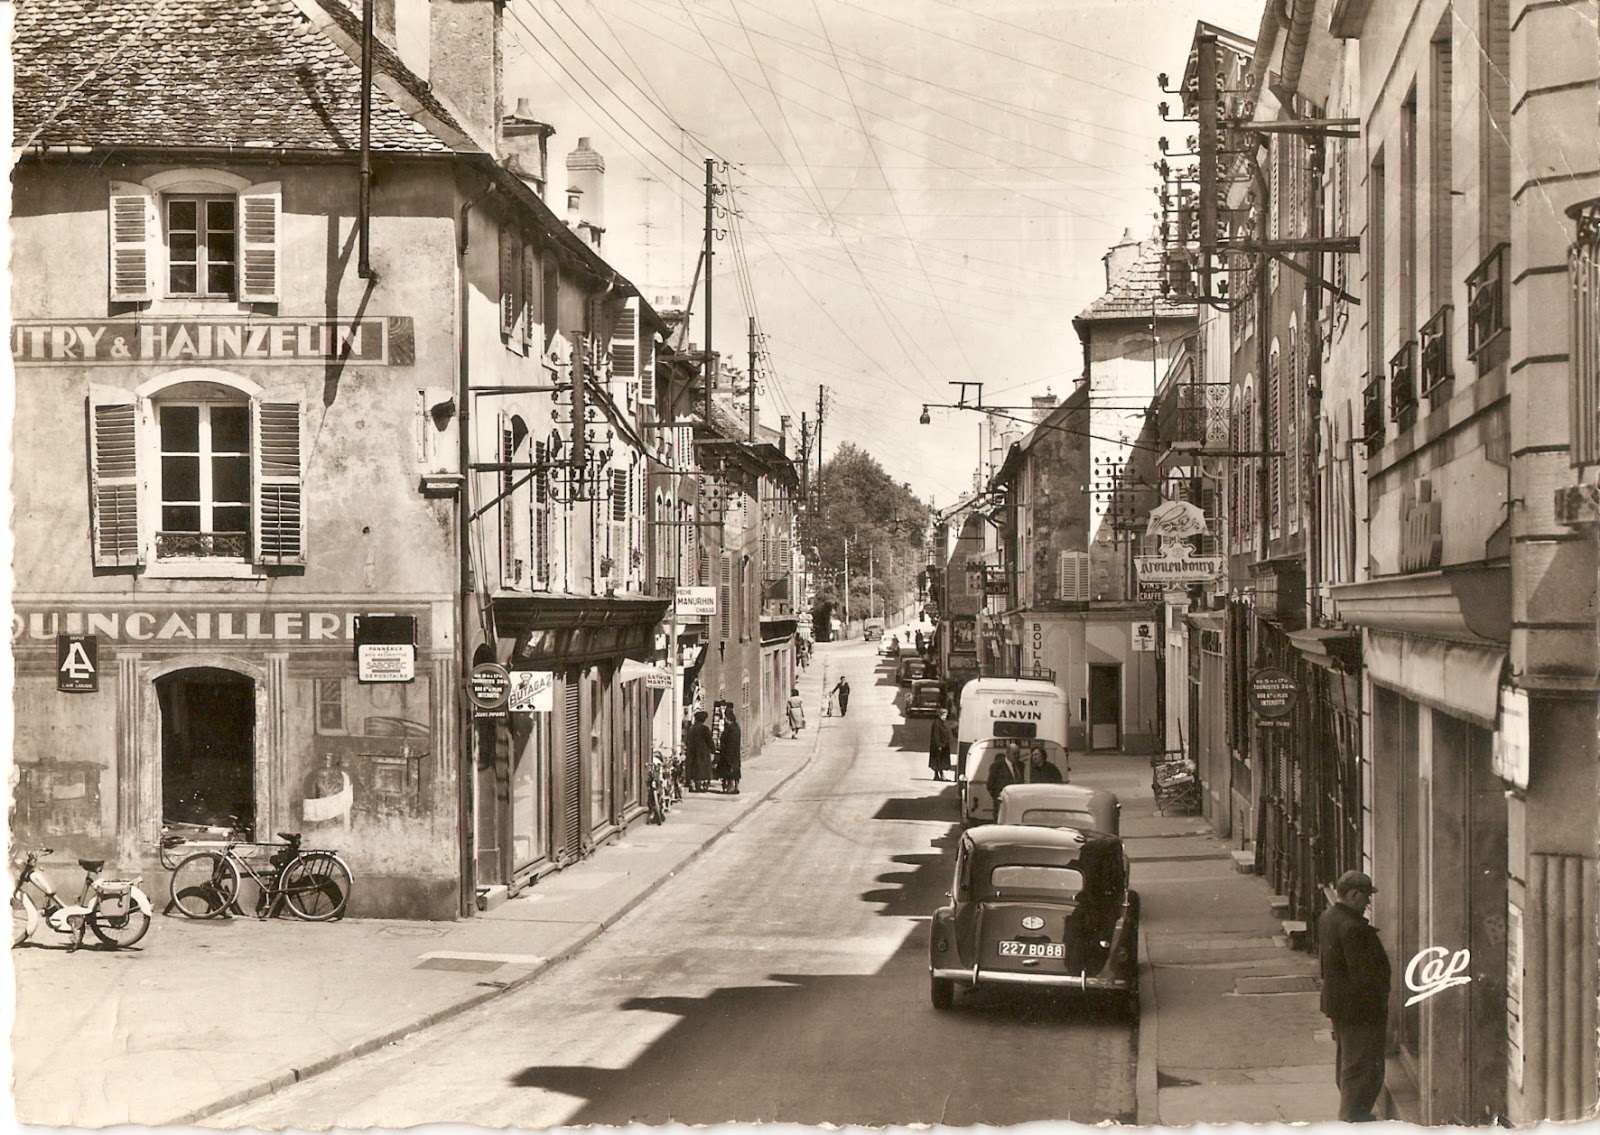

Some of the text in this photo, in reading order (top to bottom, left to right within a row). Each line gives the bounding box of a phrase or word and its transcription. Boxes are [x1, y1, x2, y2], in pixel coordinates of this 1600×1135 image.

[110, 336, 132, 358] &
[140, 324, 363, 358] HAINZELIN
[1140, 559, 1215, 574] Kronenbourg
[677, 597, 714, 606] MANURHIN
[510, 673, 552, 706] BUTAGAZ
[992, 698, 1039, 706] CHOCOLAT
[989, 709, 1042, 720] LANVIN
[1002, 943, 1027, 955] 227
